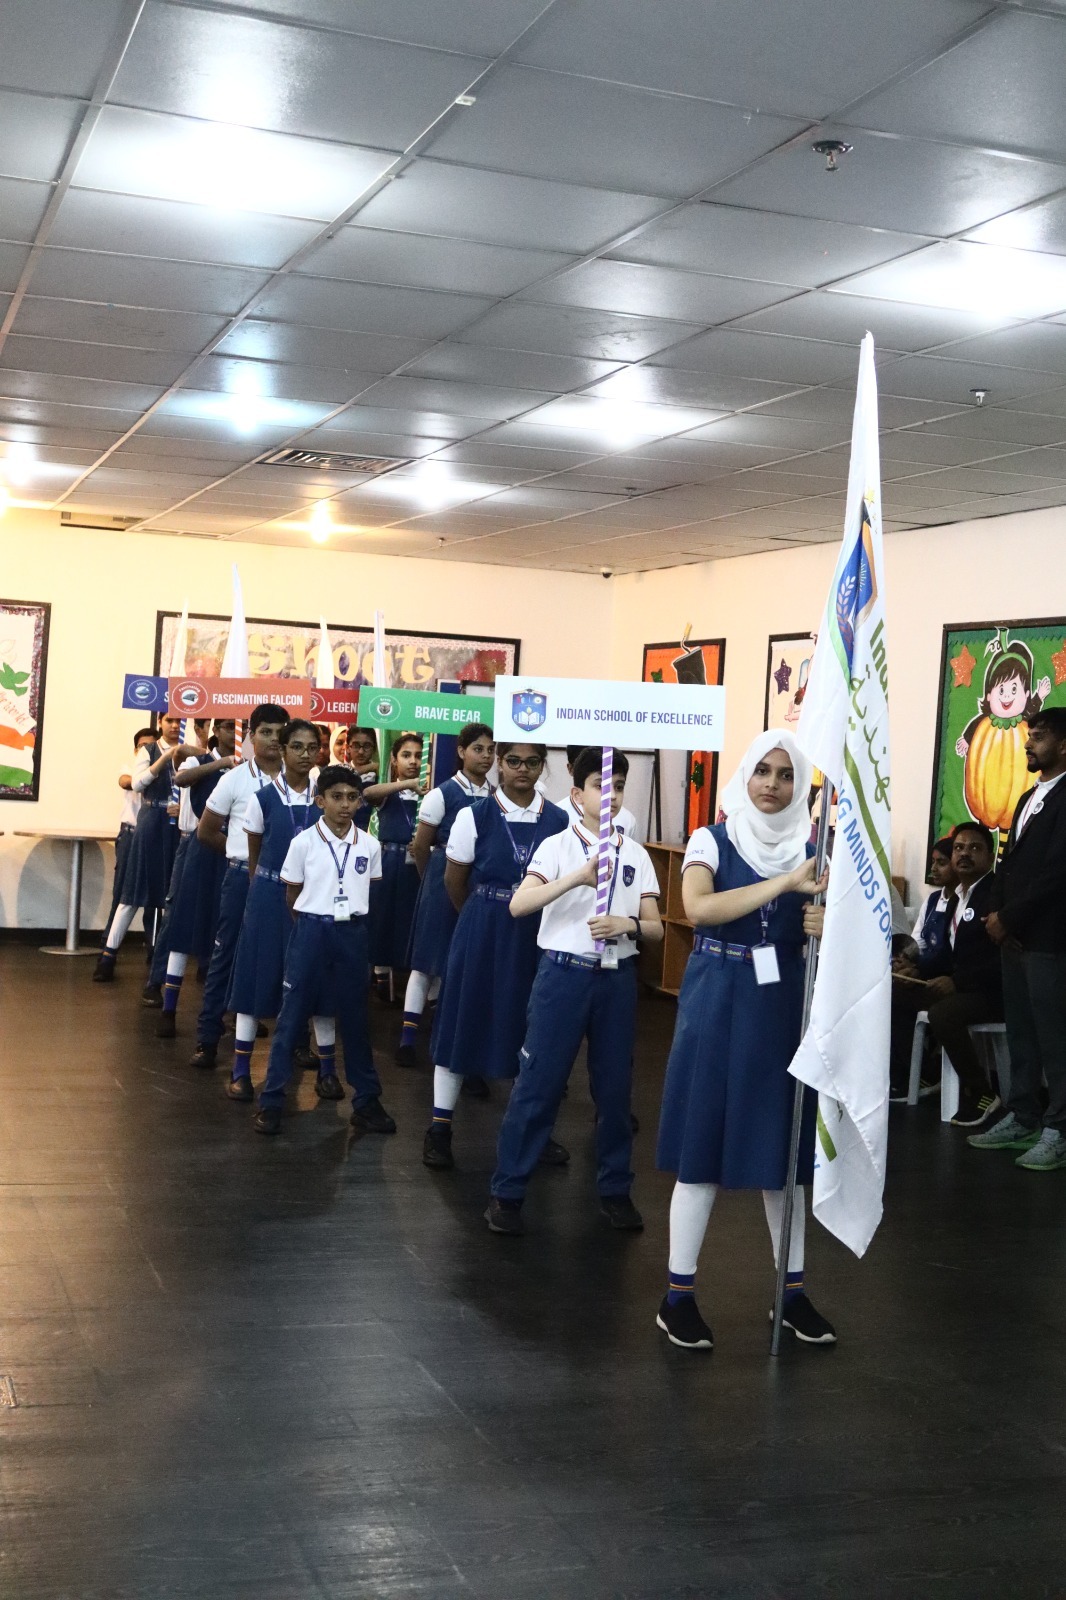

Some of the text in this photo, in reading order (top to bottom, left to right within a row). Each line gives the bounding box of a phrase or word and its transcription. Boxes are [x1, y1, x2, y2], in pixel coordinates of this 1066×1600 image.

[212, 693, 269, 705] FASCINATING
[270, 694, 303, 706] FALCON
[327, 701, 359, 714] LEGEN
[414, 705, 481, 723] BRAVE BEAR
[556, 707, 713, 726] INDIAN SCHOOL OF EXCELLENCE
[843, 818, 880, 901] MINDS
